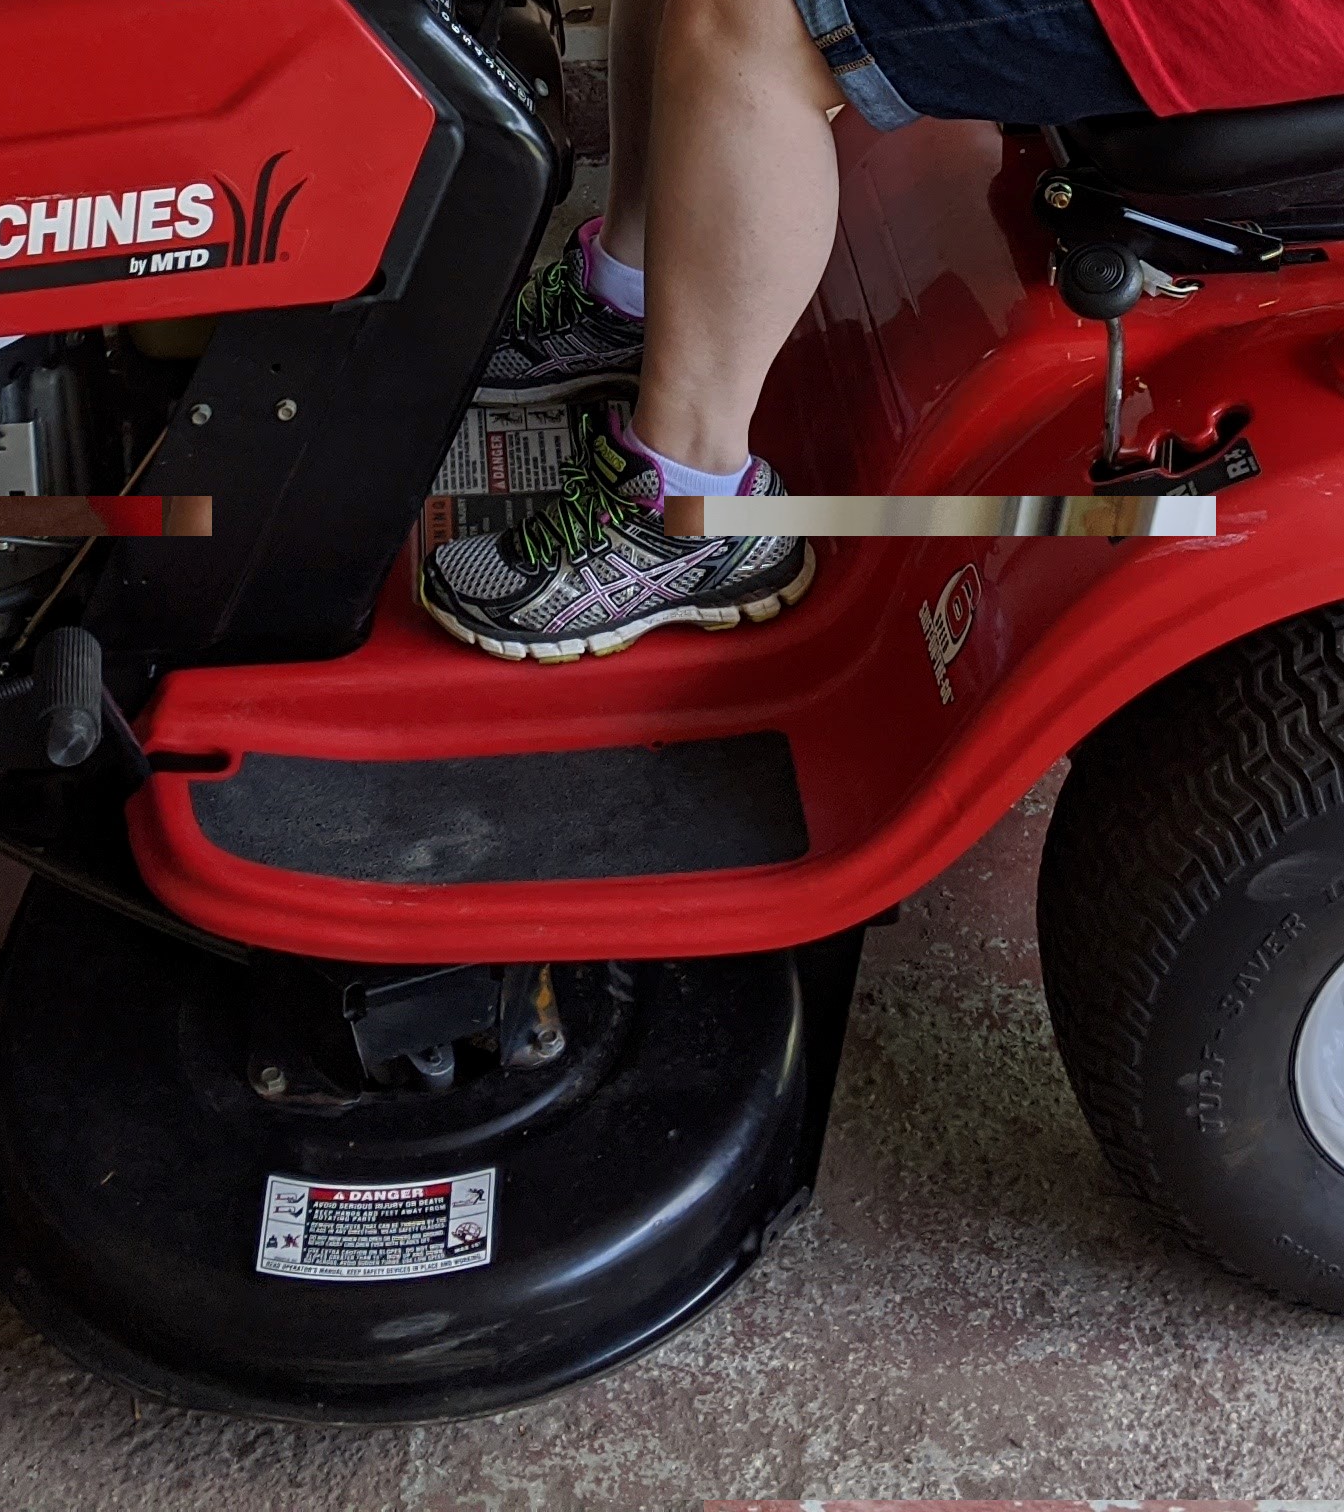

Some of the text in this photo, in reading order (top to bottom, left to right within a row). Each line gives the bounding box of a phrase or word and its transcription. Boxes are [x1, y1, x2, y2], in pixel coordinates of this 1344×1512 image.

[129, 249, 210, 276] by MTD
[491, 435, 505, 479] DANGER
[1198, 911, 1308, 1135] TURF-SAVER
[348, 1188, 425, 1202] DANGER
[419, 1197, 444, 1207] DEATH
[401, 1207, 423, 1215] AWAY
